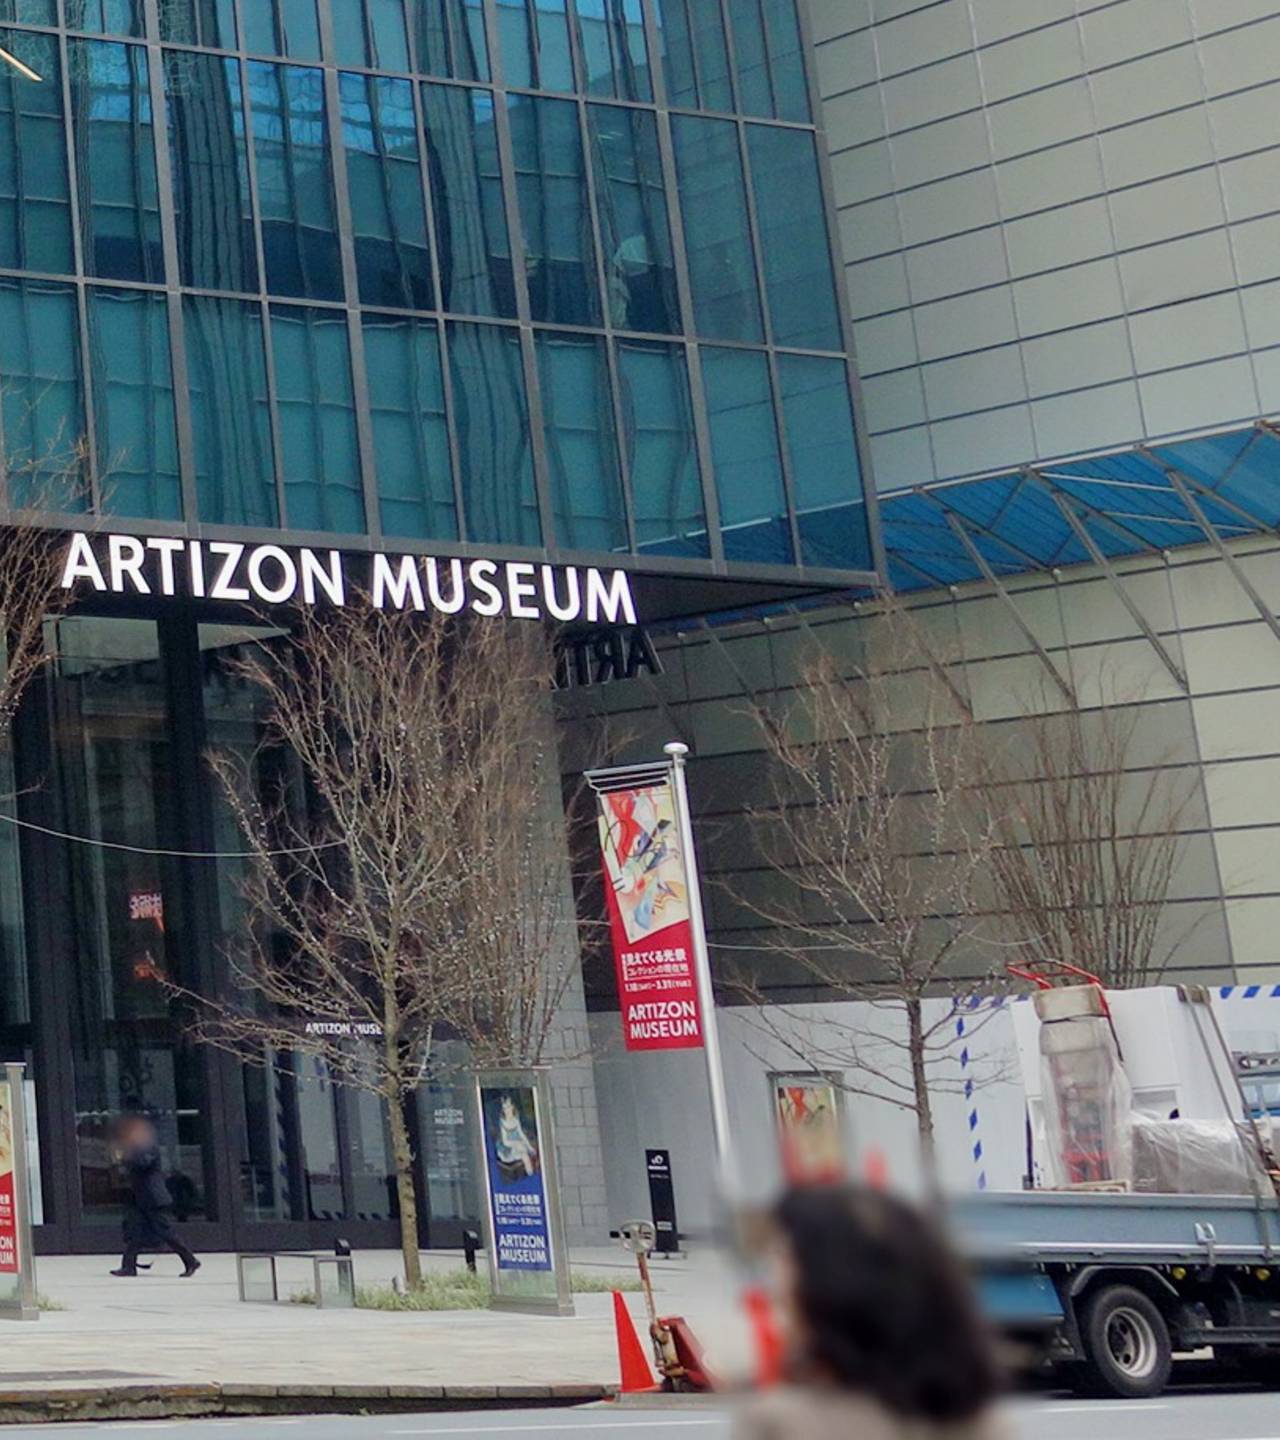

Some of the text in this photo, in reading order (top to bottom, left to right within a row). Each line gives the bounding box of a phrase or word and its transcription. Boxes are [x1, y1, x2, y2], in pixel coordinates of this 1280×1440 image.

[61, 532, 638, 626] ARTIZON MUSEUM
[628, 1000, 696, 1022] ARTIZON
[305, 1022, 351, 1034] ARTIZON
[630, 1019, 698, 1039] MUSEUM
[499, 1234, 545, 1249] ARTIZON
[500, 1248, 547, 1263] MUSEUM
